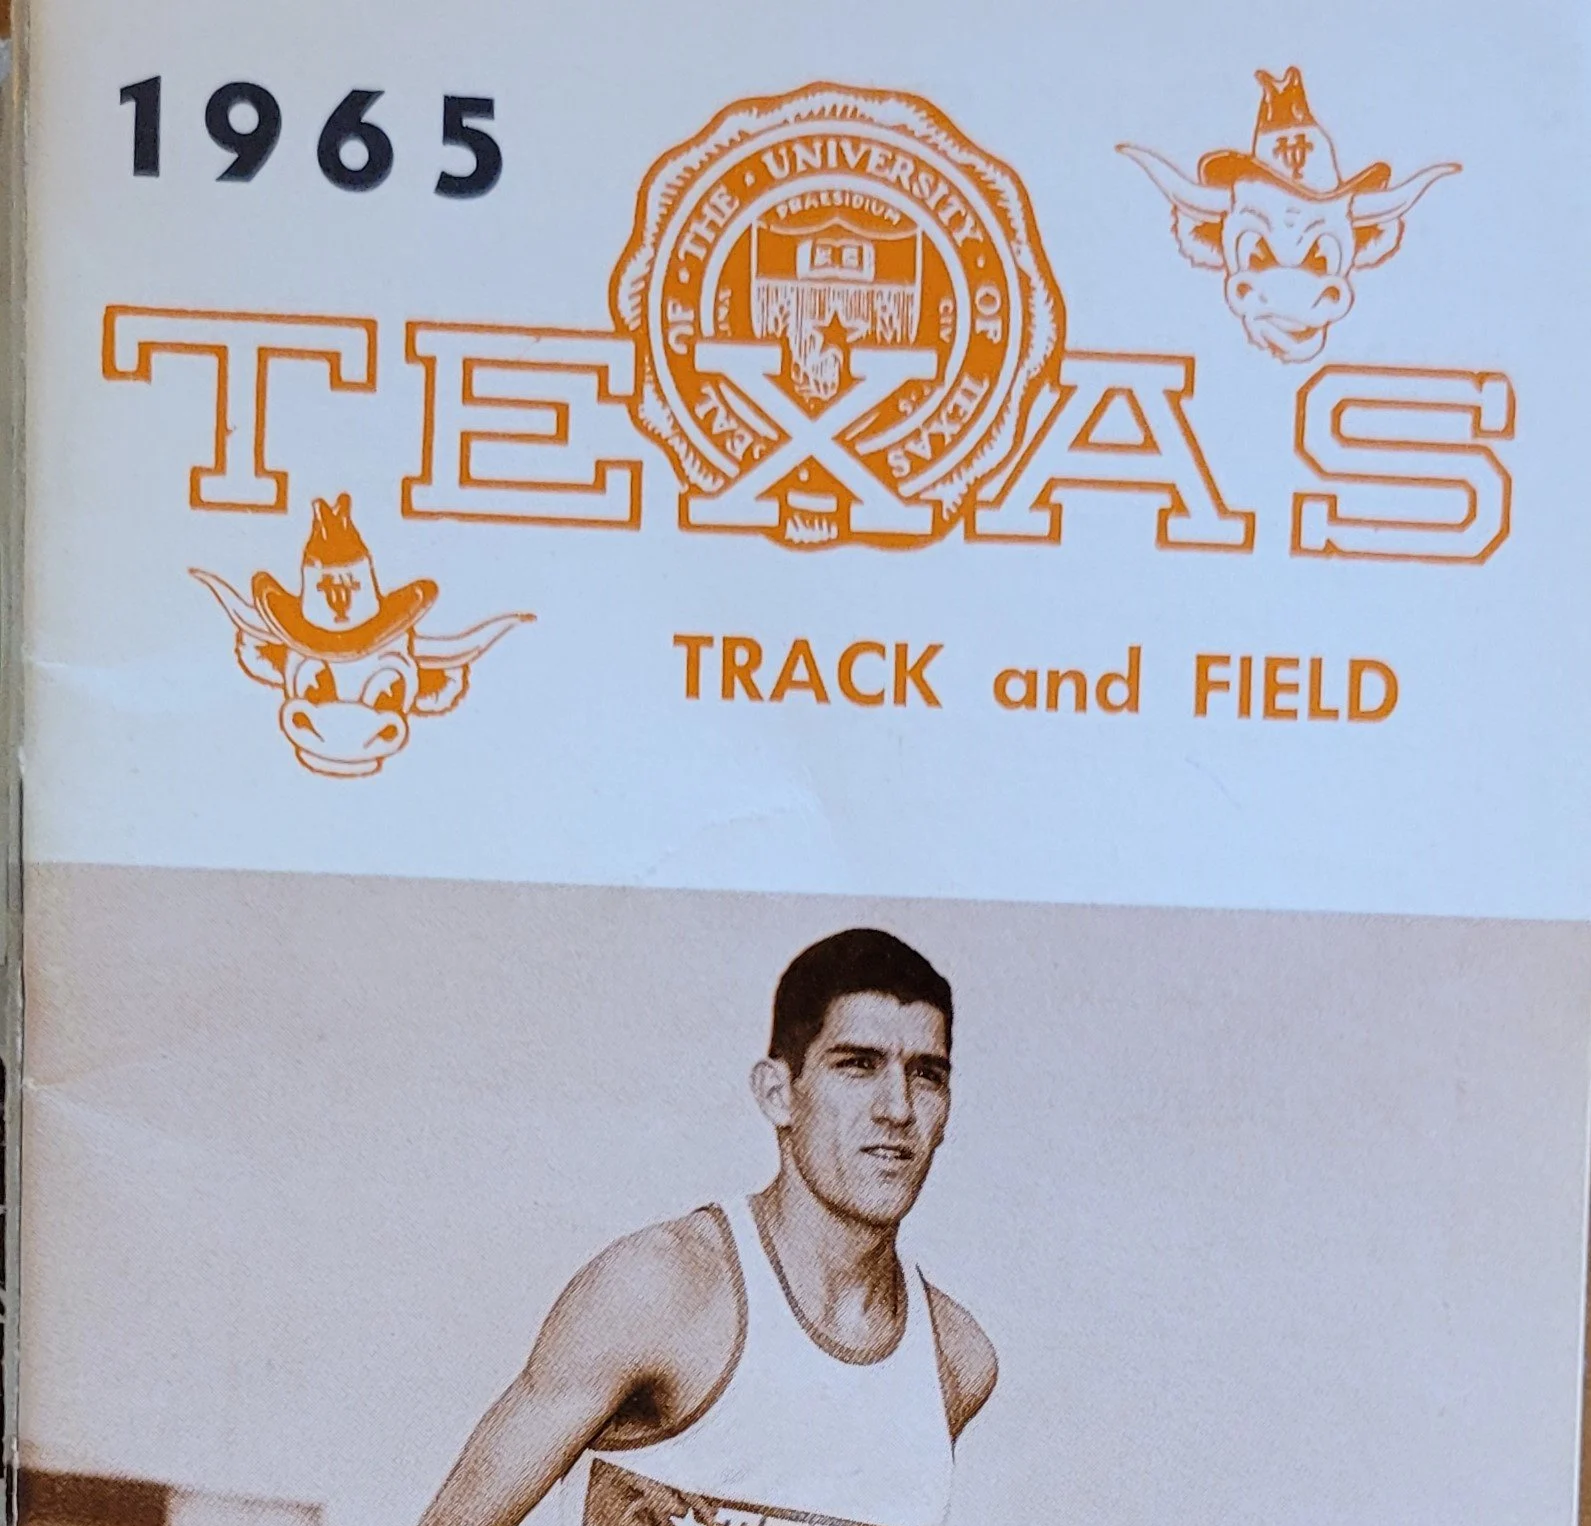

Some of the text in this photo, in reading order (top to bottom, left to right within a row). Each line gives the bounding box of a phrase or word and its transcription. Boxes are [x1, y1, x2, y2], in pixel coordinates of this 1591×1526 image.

[119, 74, 503, 200] 1965
[776, 189, 901, 226] PRAESIDIUM
[679, 137, 1002, 478] THE UNIVERSITY OF TEXAS
[102, 305, 1516, 566] TEXAS
[672, 634, 1400, 723] TRACK and FIELD
